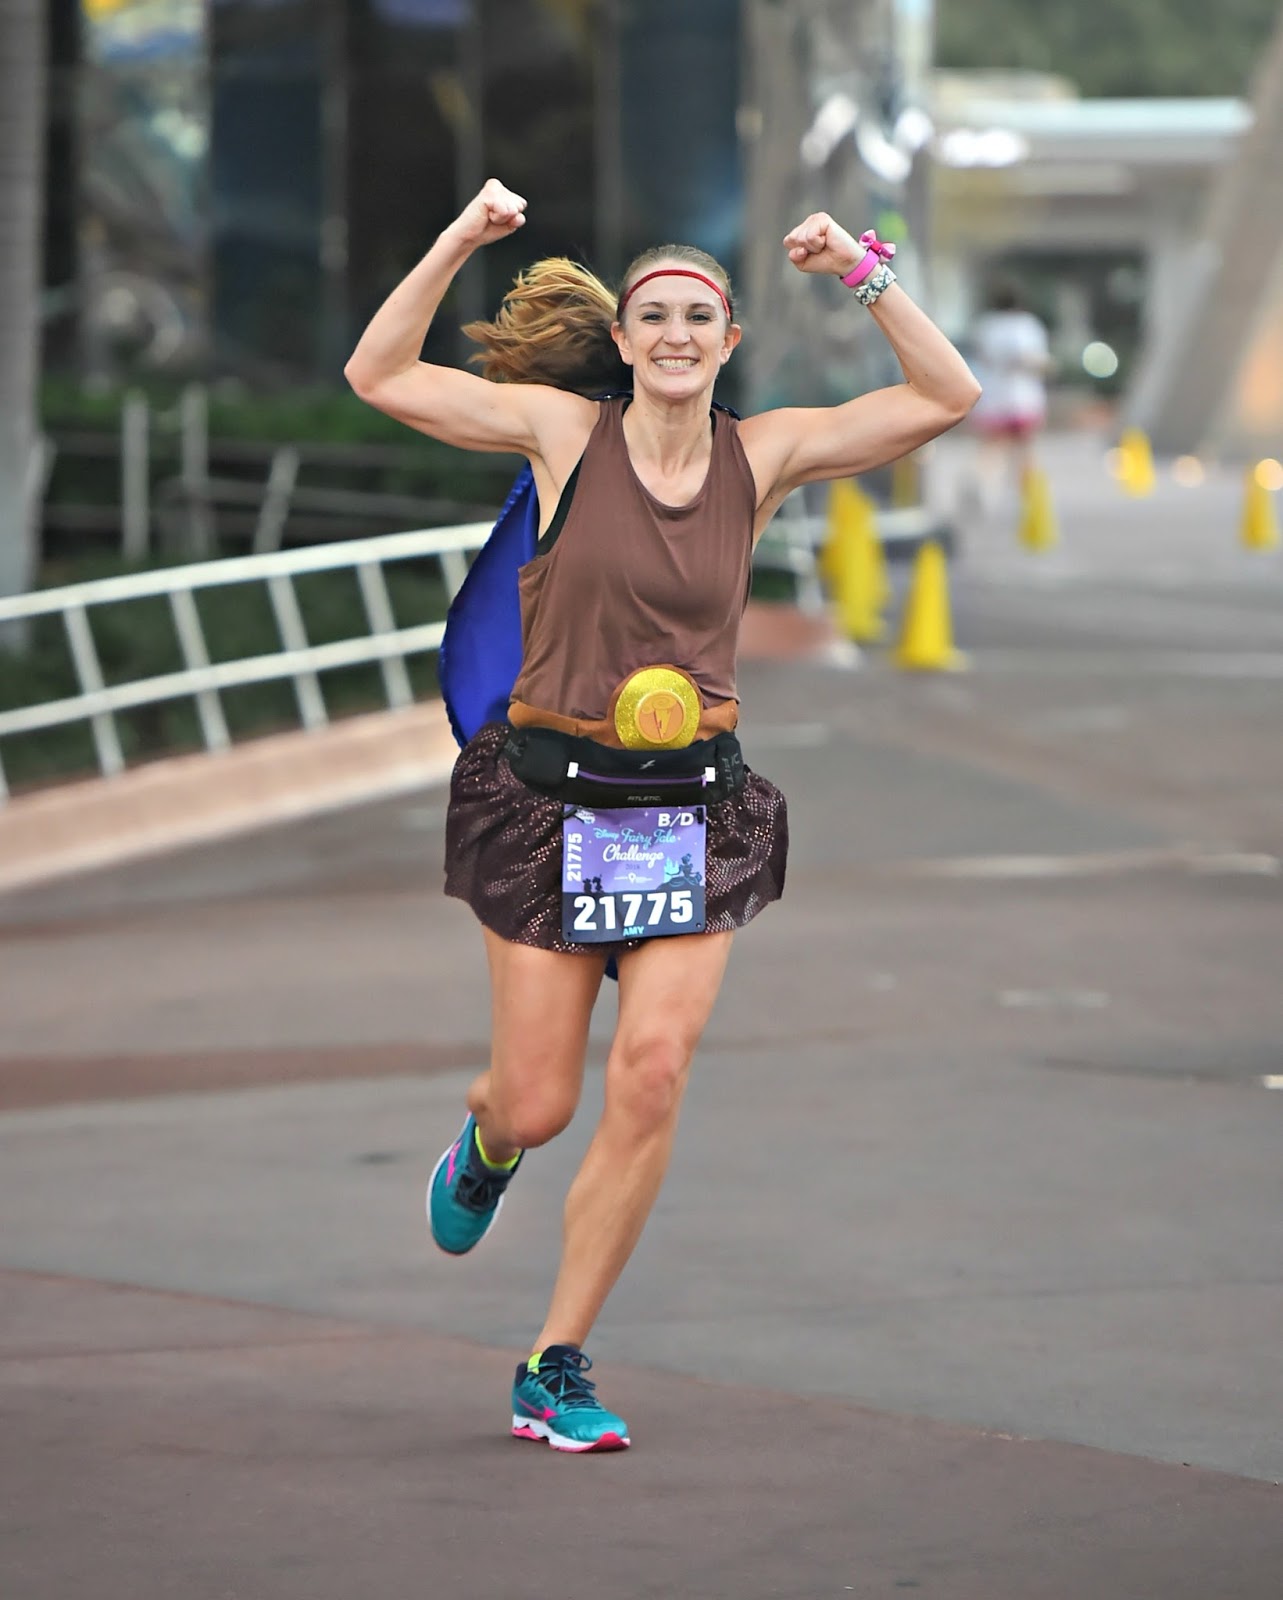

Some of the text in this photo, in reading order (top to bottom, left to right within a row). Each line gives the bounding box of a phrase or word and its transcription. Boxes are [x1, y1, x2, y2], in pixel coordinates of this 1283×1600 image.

[657, 812, 694, 827] B/D
[621, 827, 652, 851] Fairy
[653, 828, 677, 844] Tale
[566, 832, 583, 882] 21775
[602, 843, 664, 869] Challenge
[573, 890, 694, 931] 21775
[622, 925, 645, 938] AMY
